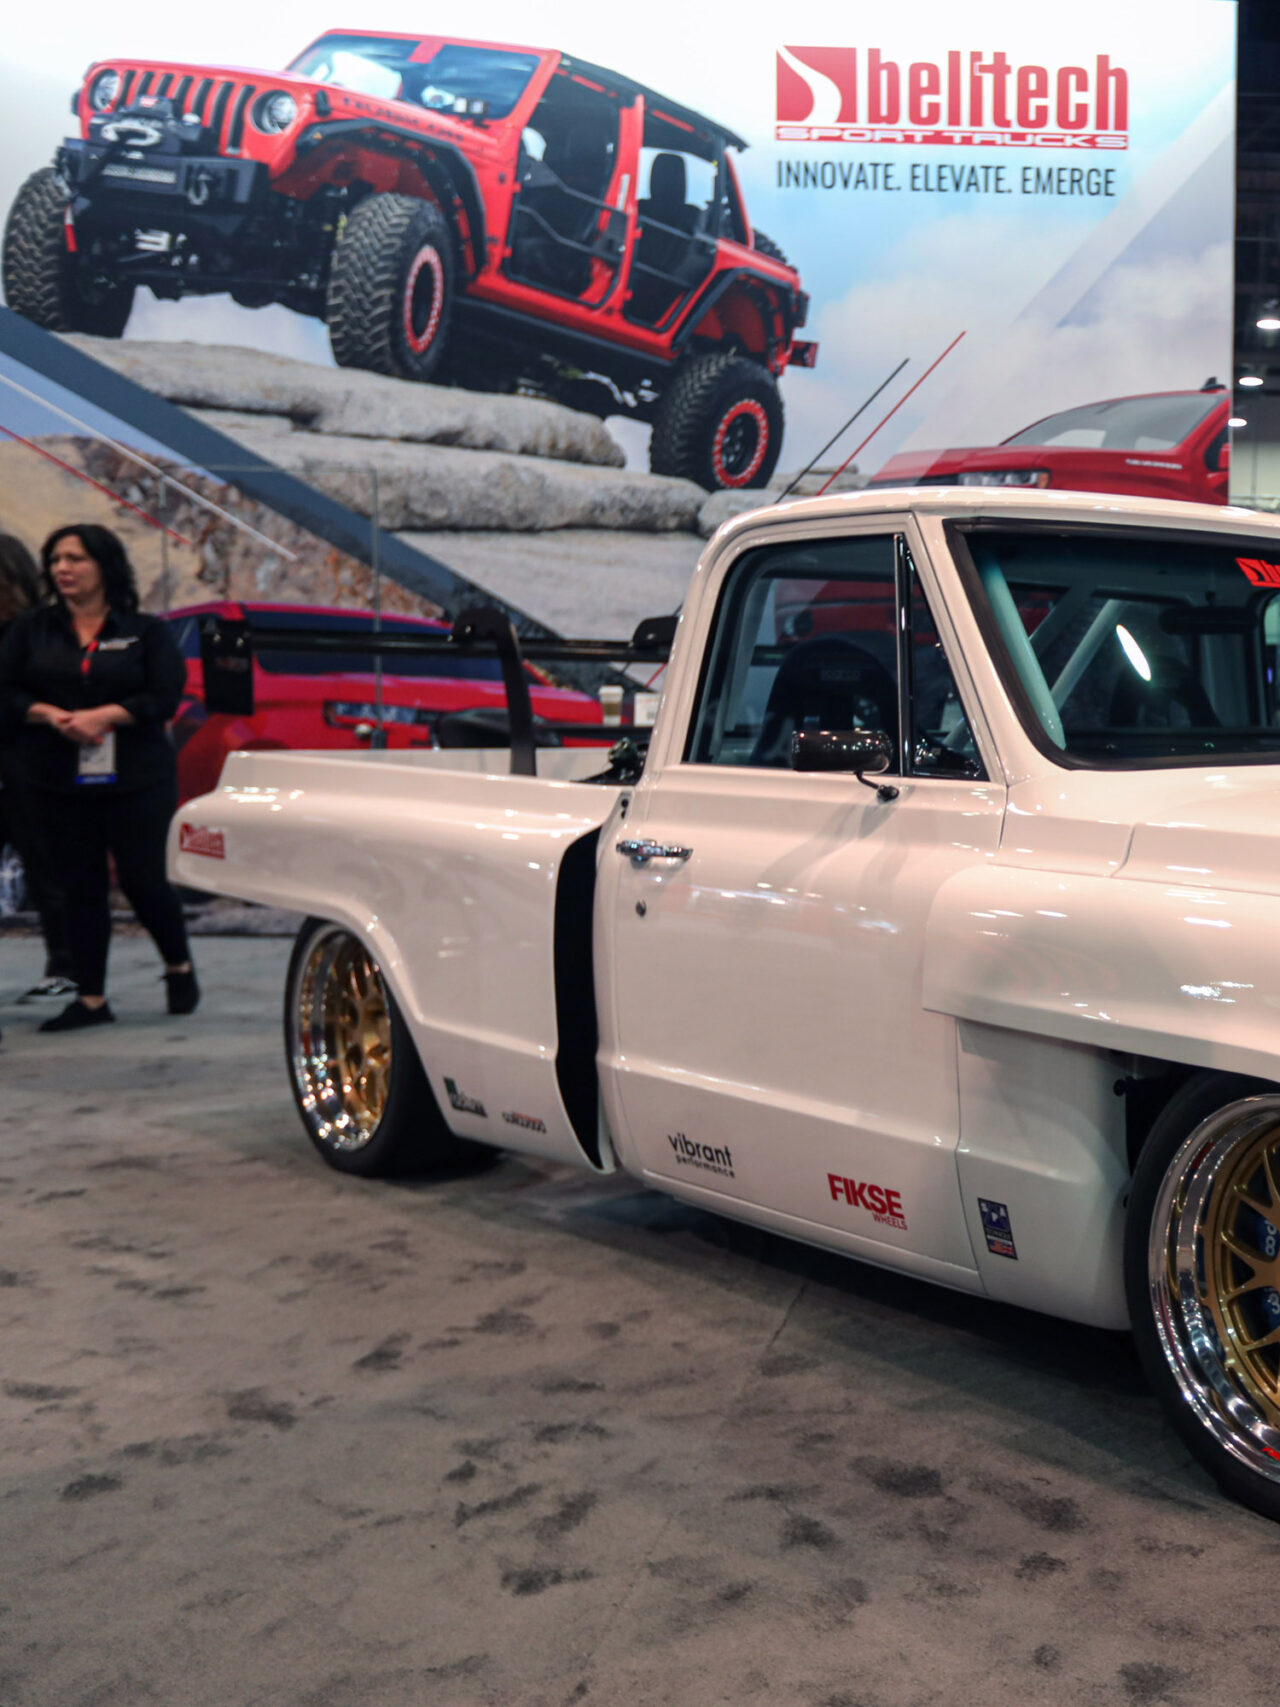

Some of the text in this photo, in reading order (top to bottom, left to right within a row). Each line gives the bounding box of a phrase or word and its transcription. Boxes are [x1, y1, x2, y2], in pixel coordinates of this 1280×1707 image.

[867, 48, 1128, 131] belltech
[778, 127, 1128, 149] SPORT TRUCKS
[776, 160, 1116, 196] INNOVATE. ELEVATE. EMERGE
[668, 1133, 733, 1168] vibrant
[675, 1154, 735, 1179] performance
[827, 1173, 905, 1220] FIKSE
[872, 1212, 907, 1231] WHEELS
